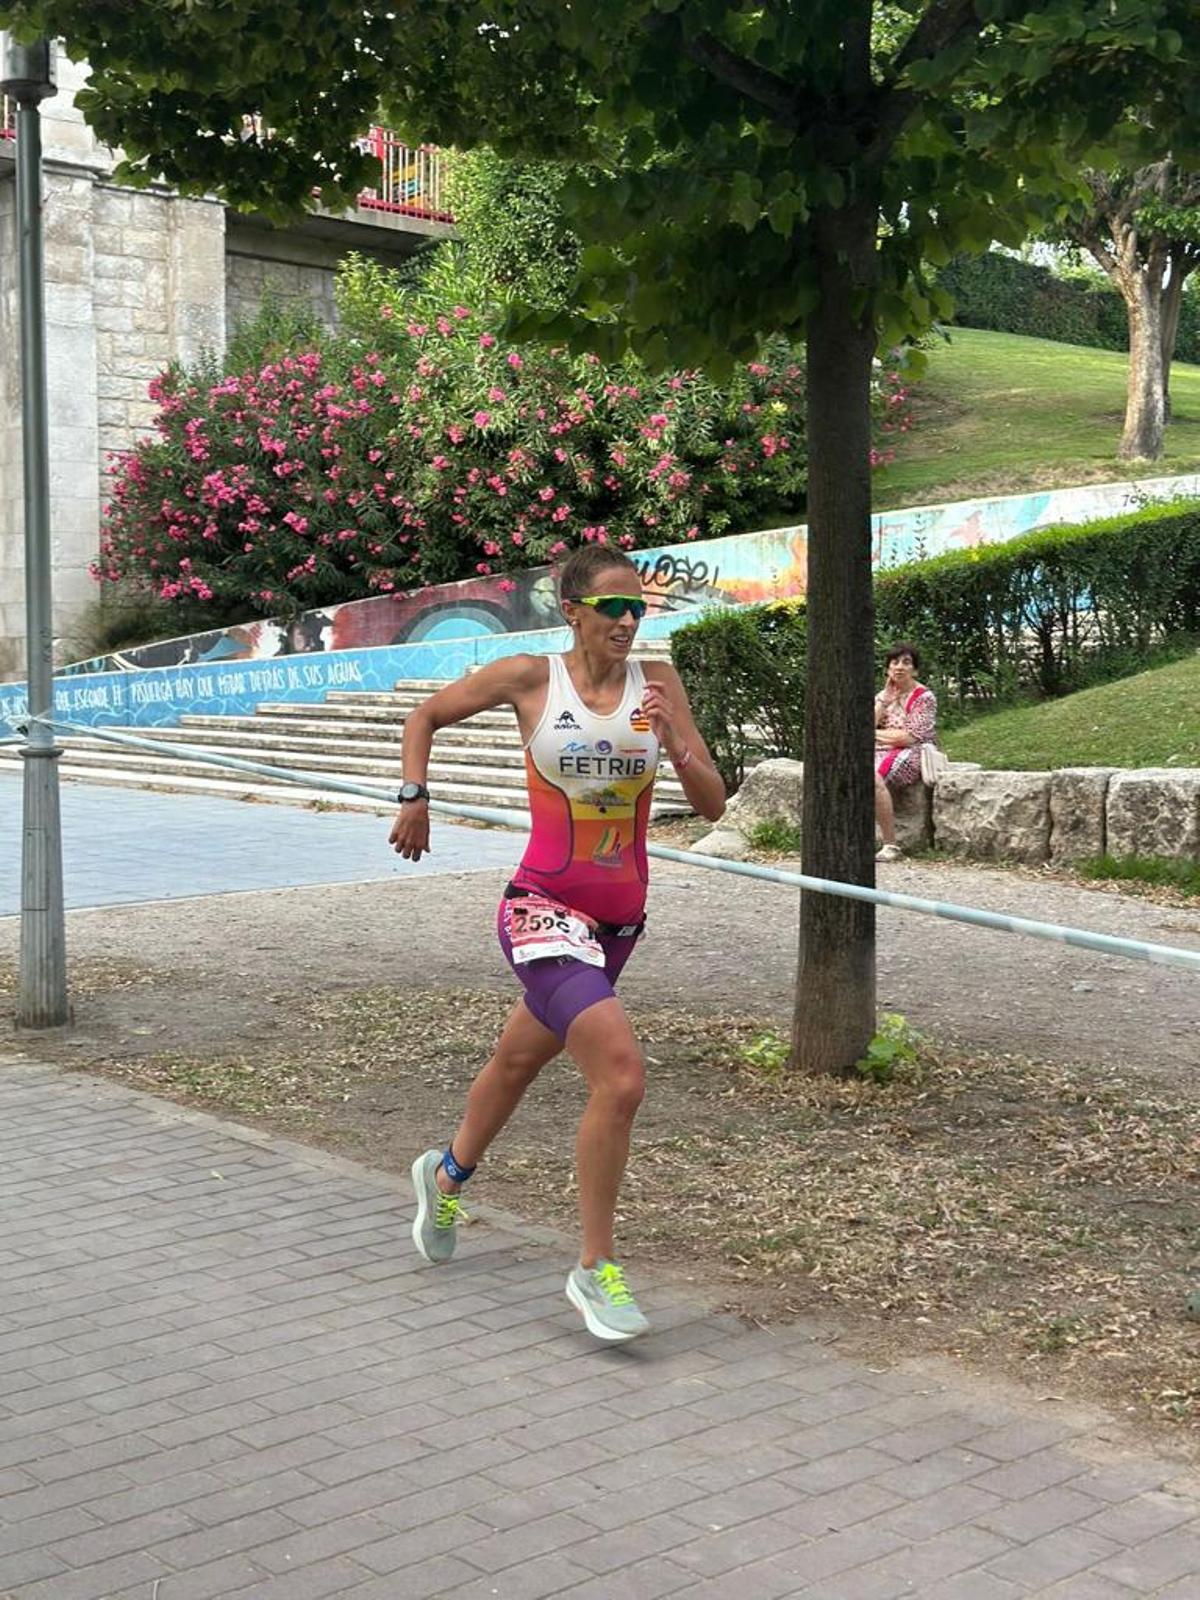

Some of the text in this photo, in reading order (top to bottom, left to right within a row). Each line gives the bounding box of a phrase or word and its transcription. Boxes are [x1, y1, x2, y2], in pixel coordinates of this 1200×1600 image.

[303, 663, 324, 687] SUS
[327, 660, 362, 685] AGUAS
[560, 756, 646, 776] FETRIB
